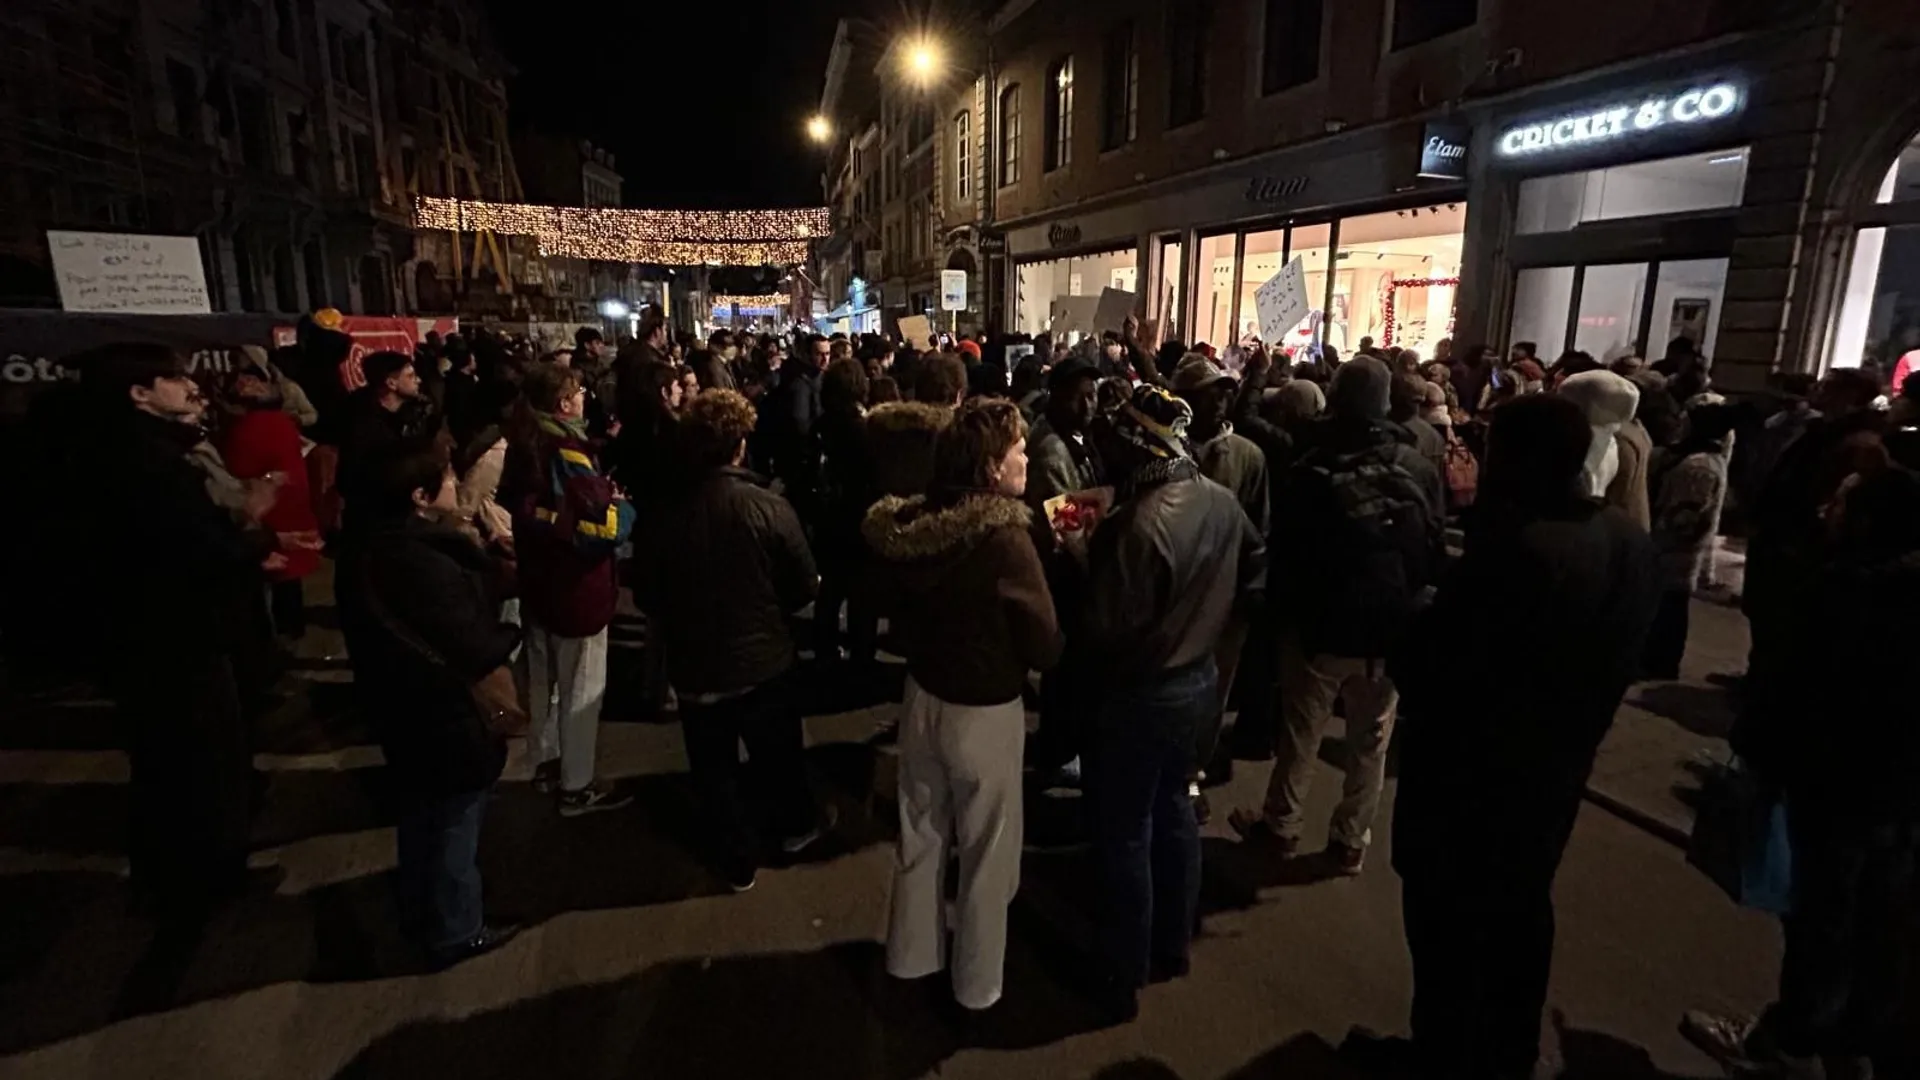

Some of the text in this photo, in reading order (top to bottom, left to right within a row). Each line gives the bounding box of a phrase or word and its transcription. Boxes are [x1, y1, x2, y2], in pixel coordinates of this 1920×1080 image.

[1501, 84, 1738, 154] CRICKET & CO
[1426, 135, 1466, 159] Etam
